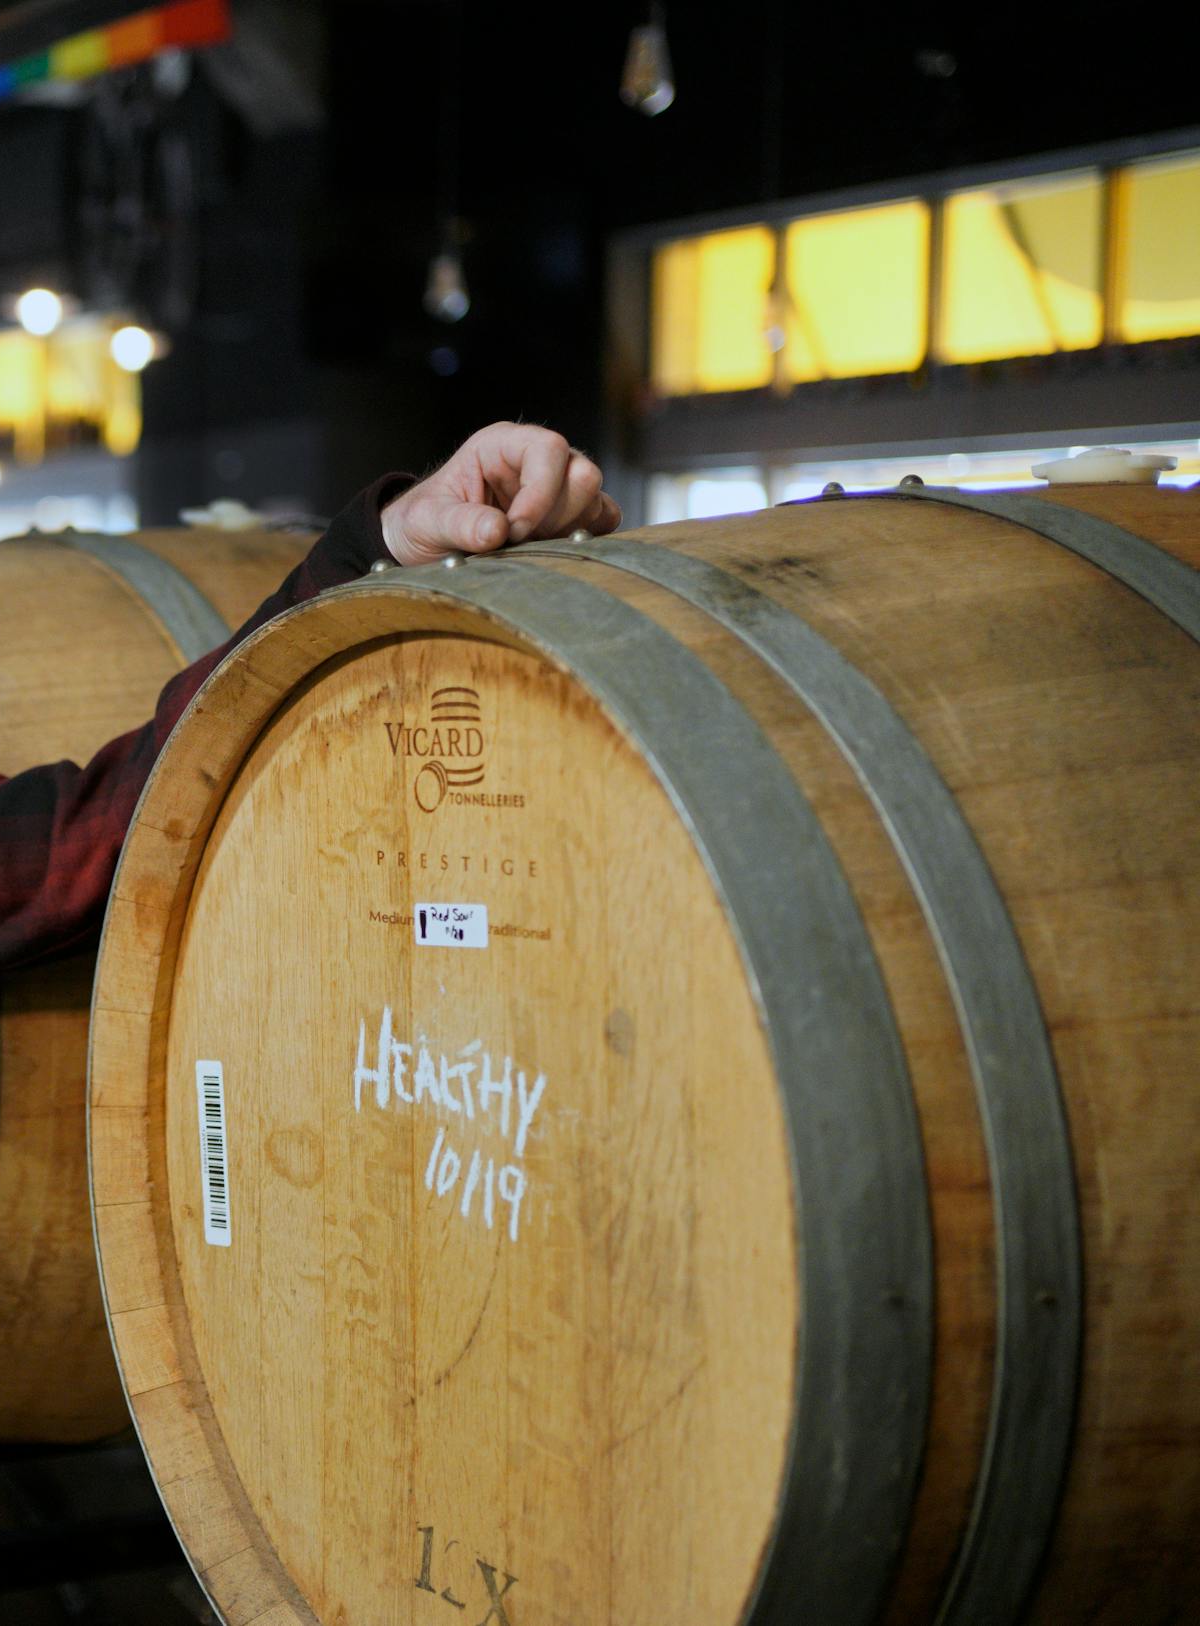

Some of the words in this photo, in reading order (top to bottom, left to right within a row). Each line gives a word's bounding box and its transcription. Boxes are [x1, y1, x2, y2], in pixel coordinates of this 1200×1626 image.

[449, 792, 525, 808] TONNELLERIES
[377, 850, 537, 877] PRESTIGE
[430, 906, 449, 922] Red
[488, 923, 551, 941] raditional
[353, 1004, 547, 1158] HEALTHY
[424, 1126, 527, 1243] 10/19
